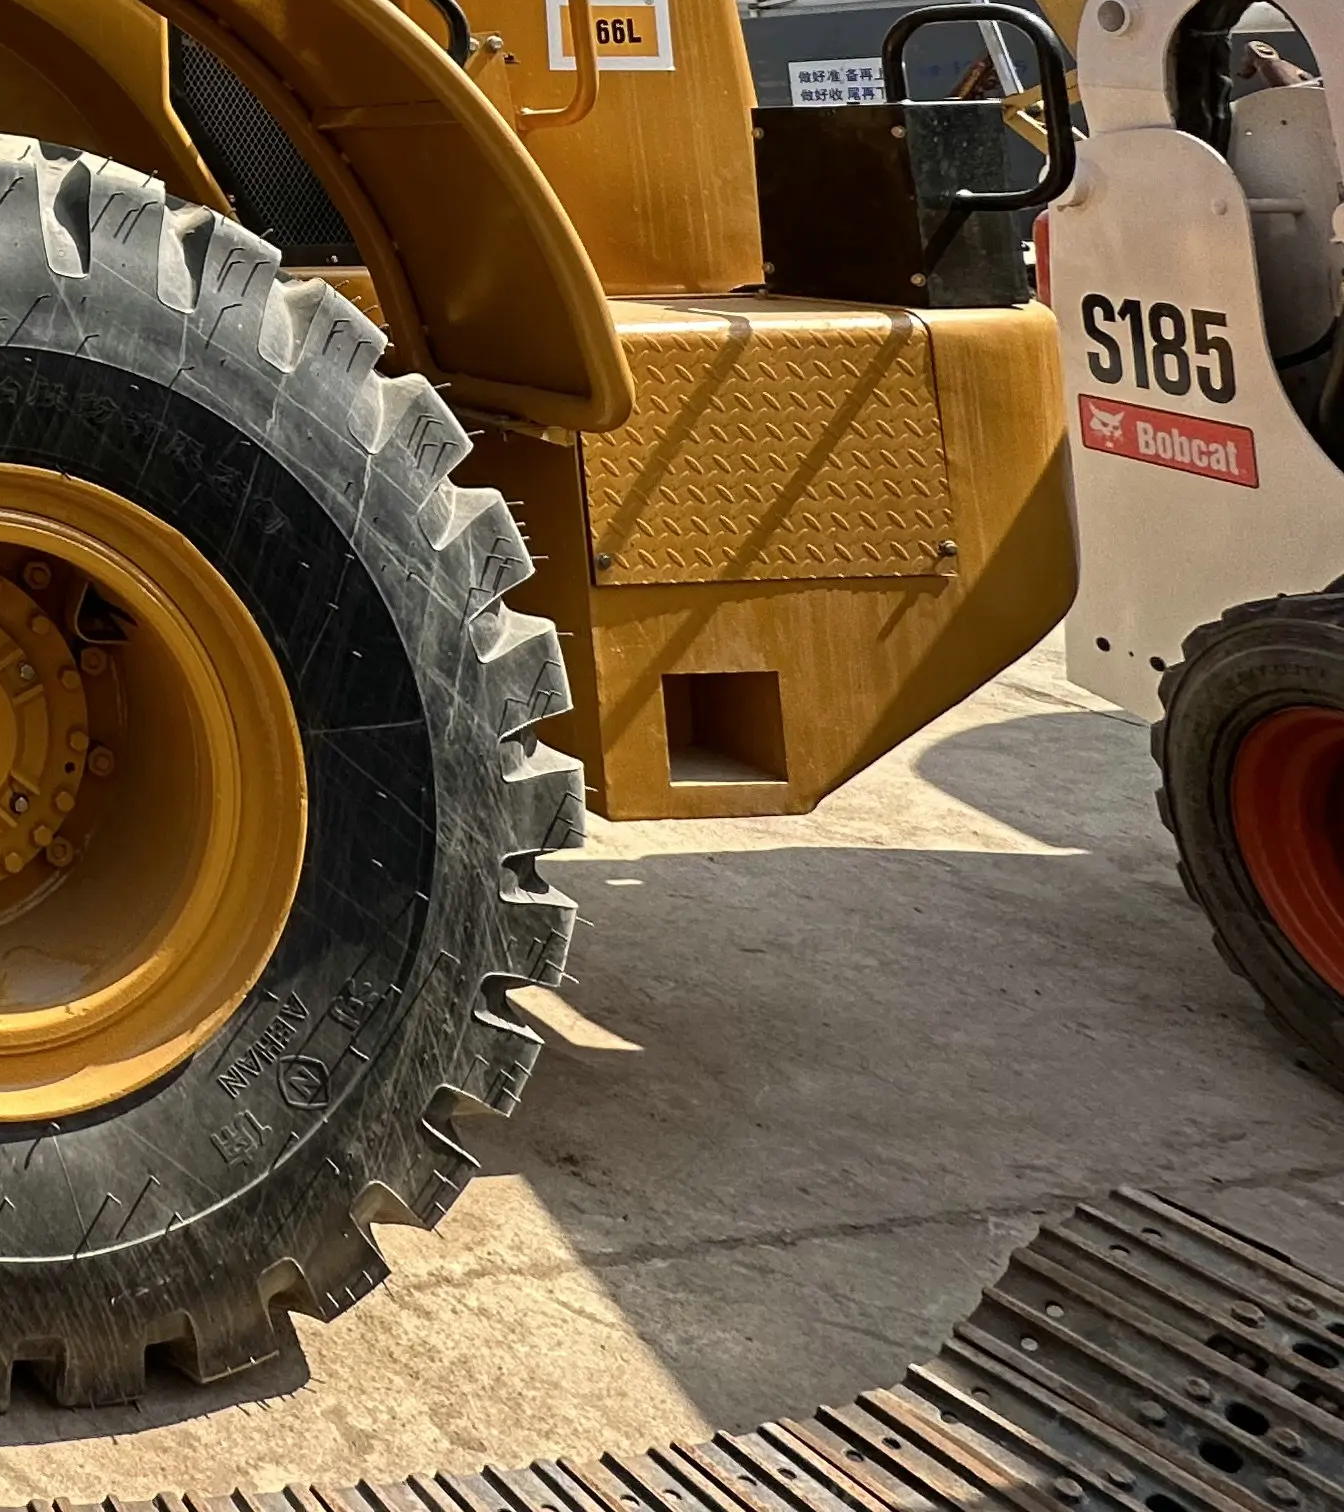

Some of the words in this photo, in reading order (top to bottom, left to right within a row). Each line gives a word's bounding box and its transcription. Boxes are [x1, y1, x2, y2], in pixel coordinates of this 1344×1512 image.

[595, 18, 642, 45] 66L
[1081, 292, 1236, 404] S185
[1136, 420, 1240, 476] Bobcat
